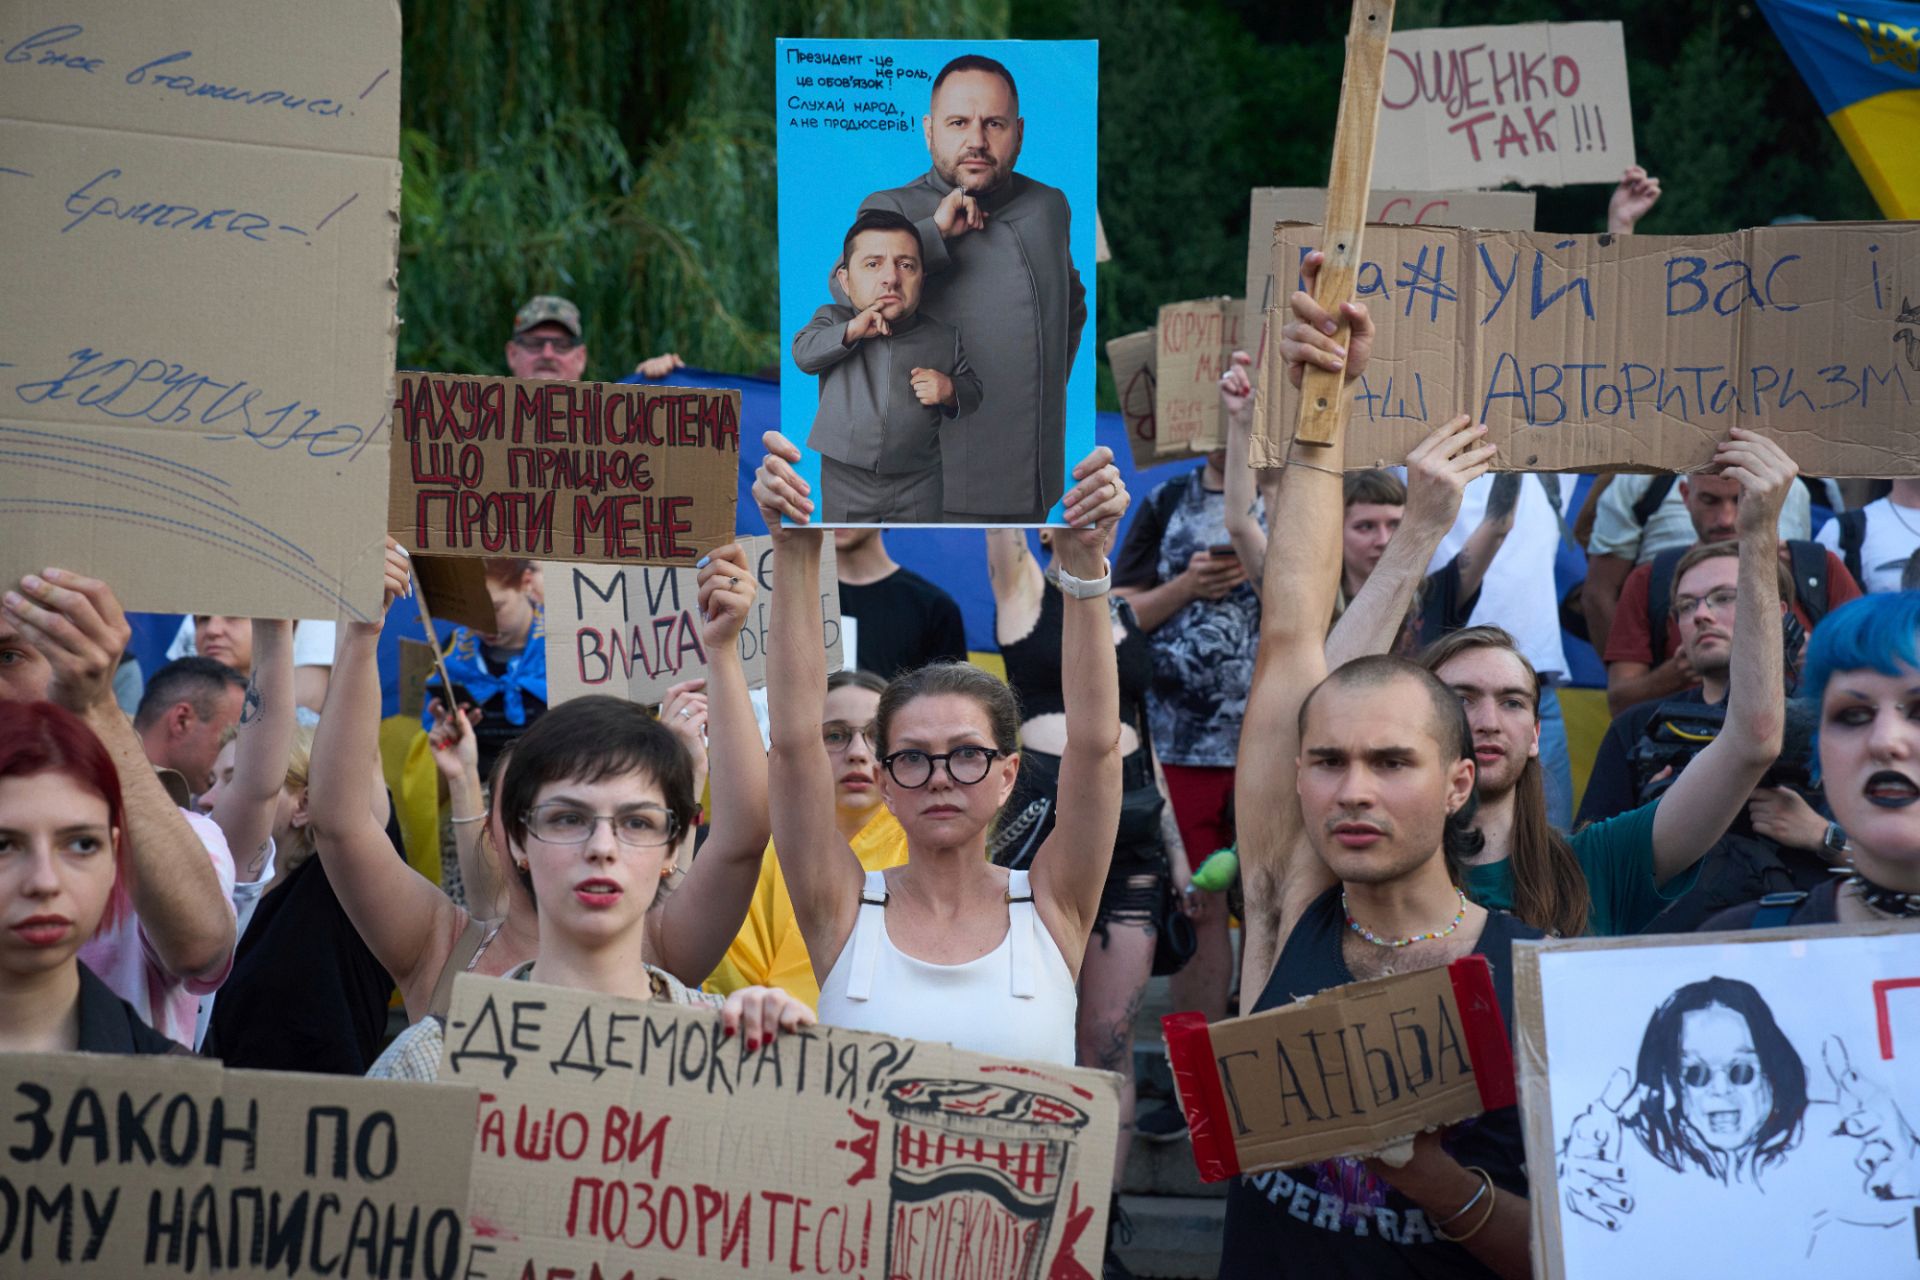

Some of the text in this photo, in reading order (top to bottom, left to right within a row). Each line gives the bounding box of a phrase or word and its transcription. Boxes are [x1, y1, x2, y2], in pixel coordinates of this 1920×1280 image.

[787, 48, 863, 65] Президент
[796, 76, 813, 87] це
[876, 68, 933, 82] не роль,
[801, 117, 818, 127] не
[512, 384, 603, 444] МЕНІ
[604, 392, 740, 453] СИСТЕМА
[411, 442, 654, 495] ЩО ПРАЦЮЄ
[415, 489, 698, 559] ПРОТИ МЕНЕ
[572, 567, 681, 622] МИ
[576, 609, 708, 685] ВЛАДА
[1217, 994, 1472, 1136] ГАНЬБА
[8, 1081, 399, 1183] ЗАКОН ПО
[602, 1105, 672, 1179] ВИ
[144, 1184, 463, 1280] НАПИСАНО
[566, 1176, 872, 1280] ПОЗОРИТЕСЬ!
